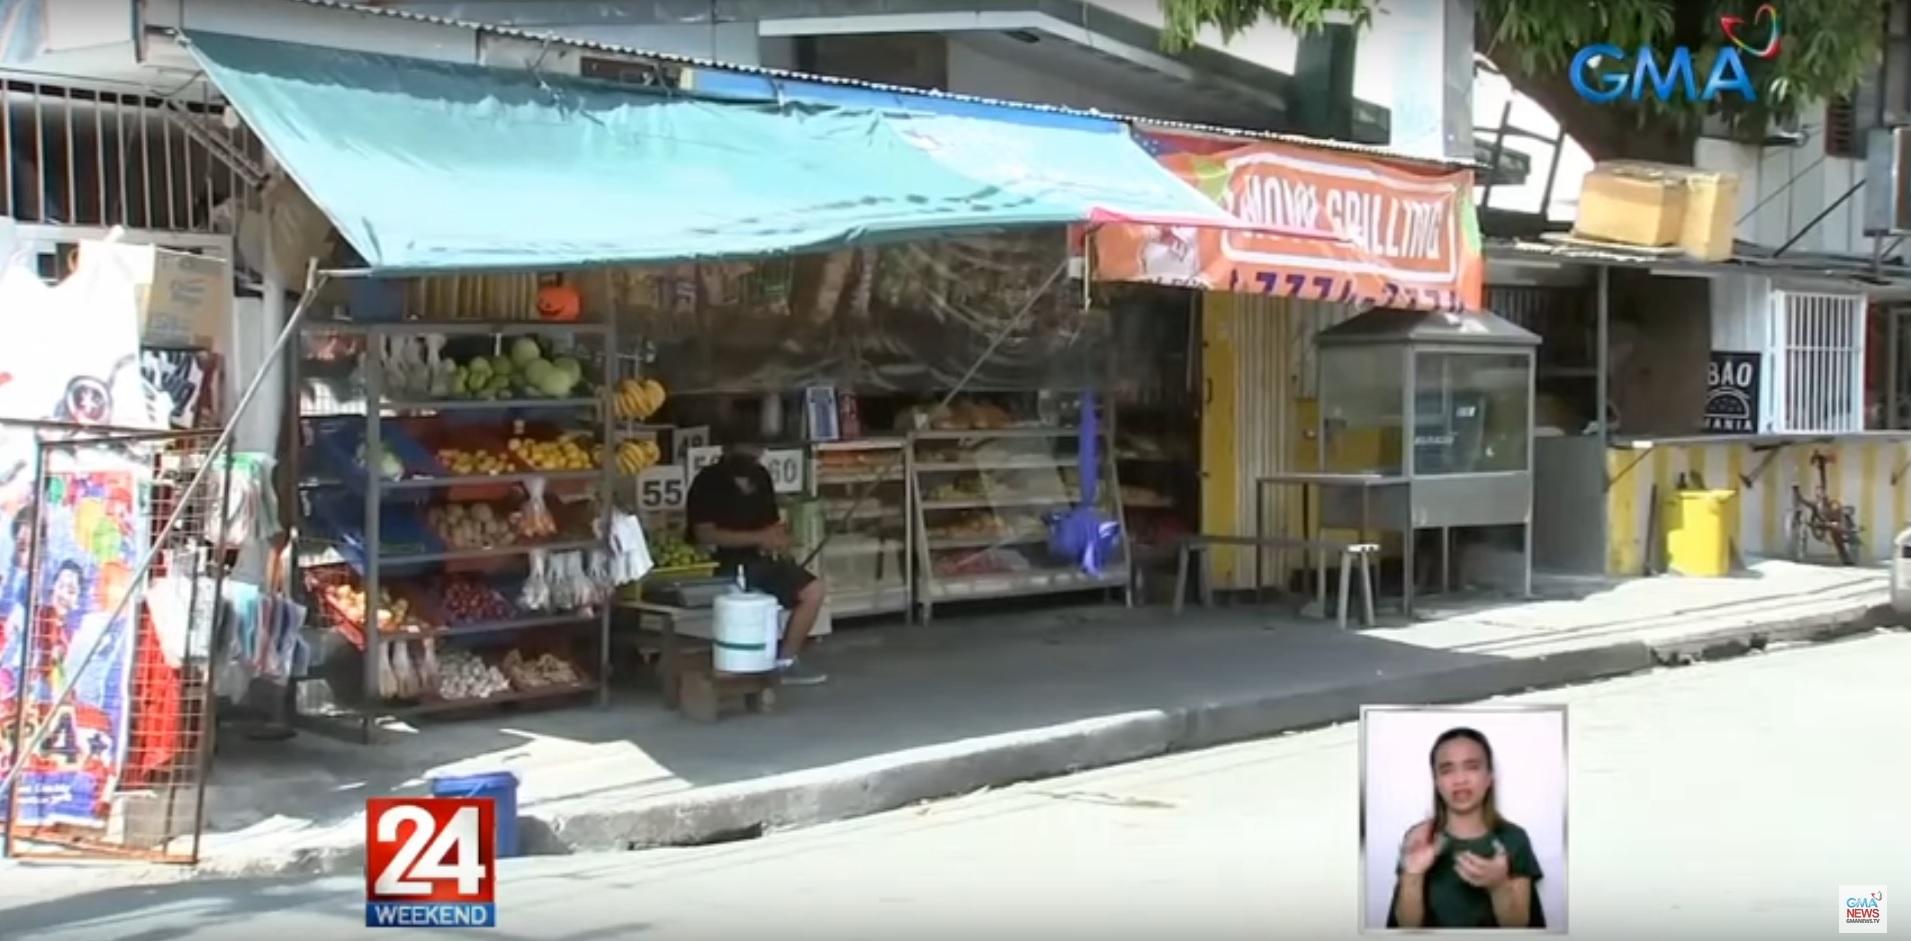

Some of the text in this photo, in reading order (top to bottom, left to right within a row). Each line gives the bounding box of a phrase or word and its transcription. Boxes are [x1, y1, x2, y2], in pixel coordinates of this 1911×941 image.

[1707, 361, 1753, 388] BAO
[767, 458, 797, 485] 60
[642, 479, 684, 506] 55
